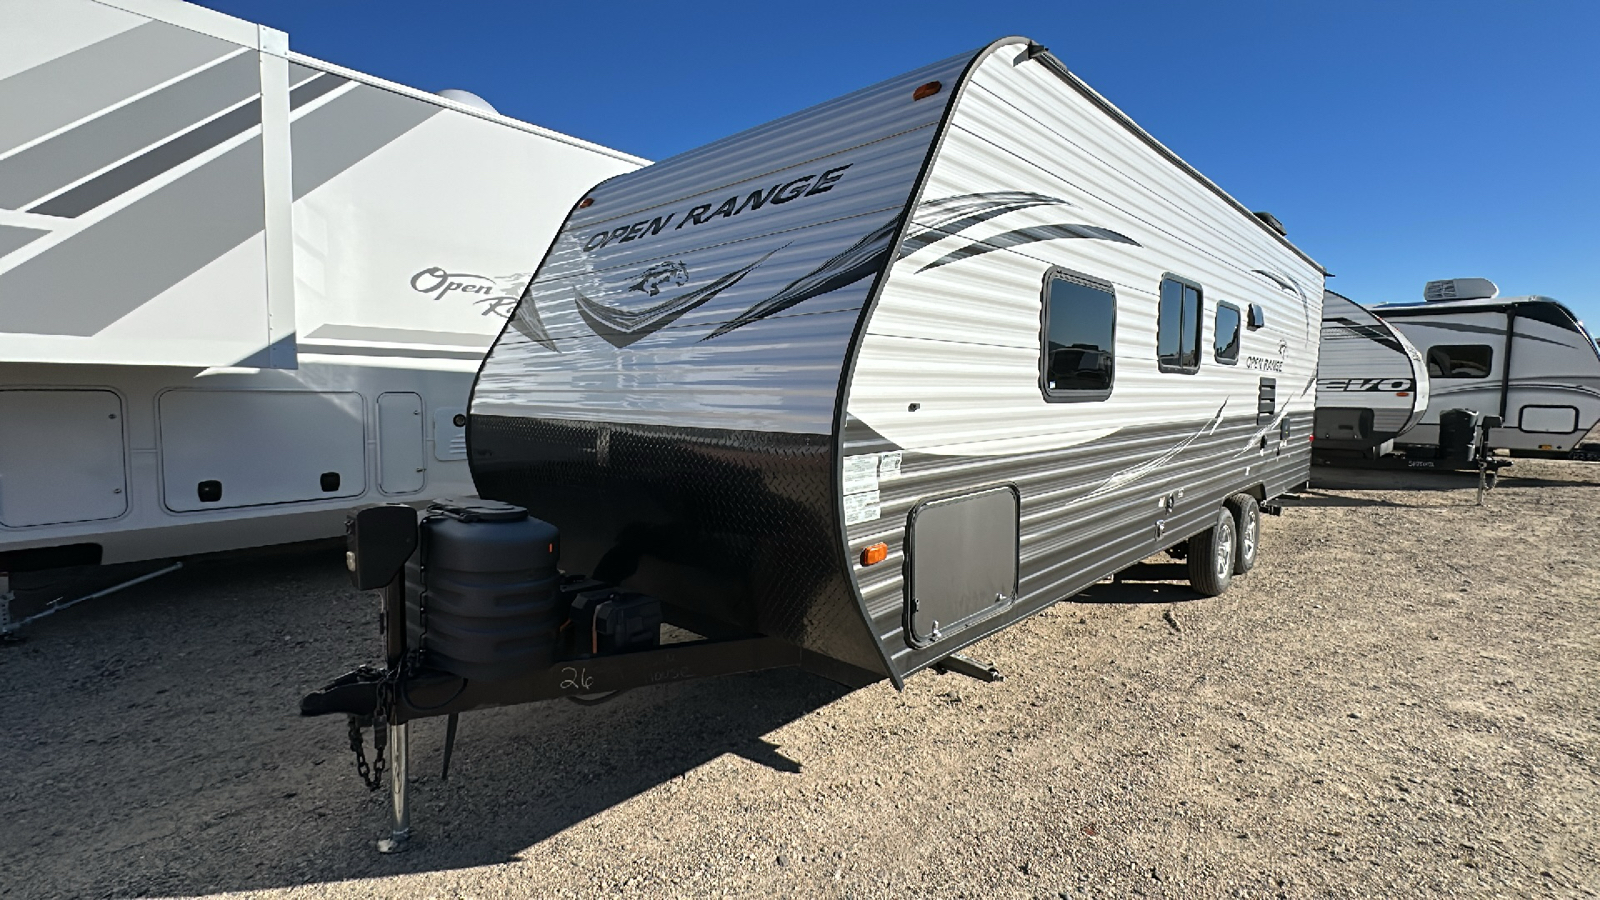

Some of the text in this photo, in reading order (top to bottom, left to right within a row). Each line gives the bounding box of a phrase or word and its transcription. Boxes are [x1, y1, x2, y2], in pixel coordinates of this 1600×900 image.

[583, 163, 854, 253] OPEN RANGE
[410, 266, 496, 301] Open
[1246, 355, 1283, 372] OPEN RANGE
[1317, 378, 1412, 391] EVO
[559, 666, 594, 690] 26
